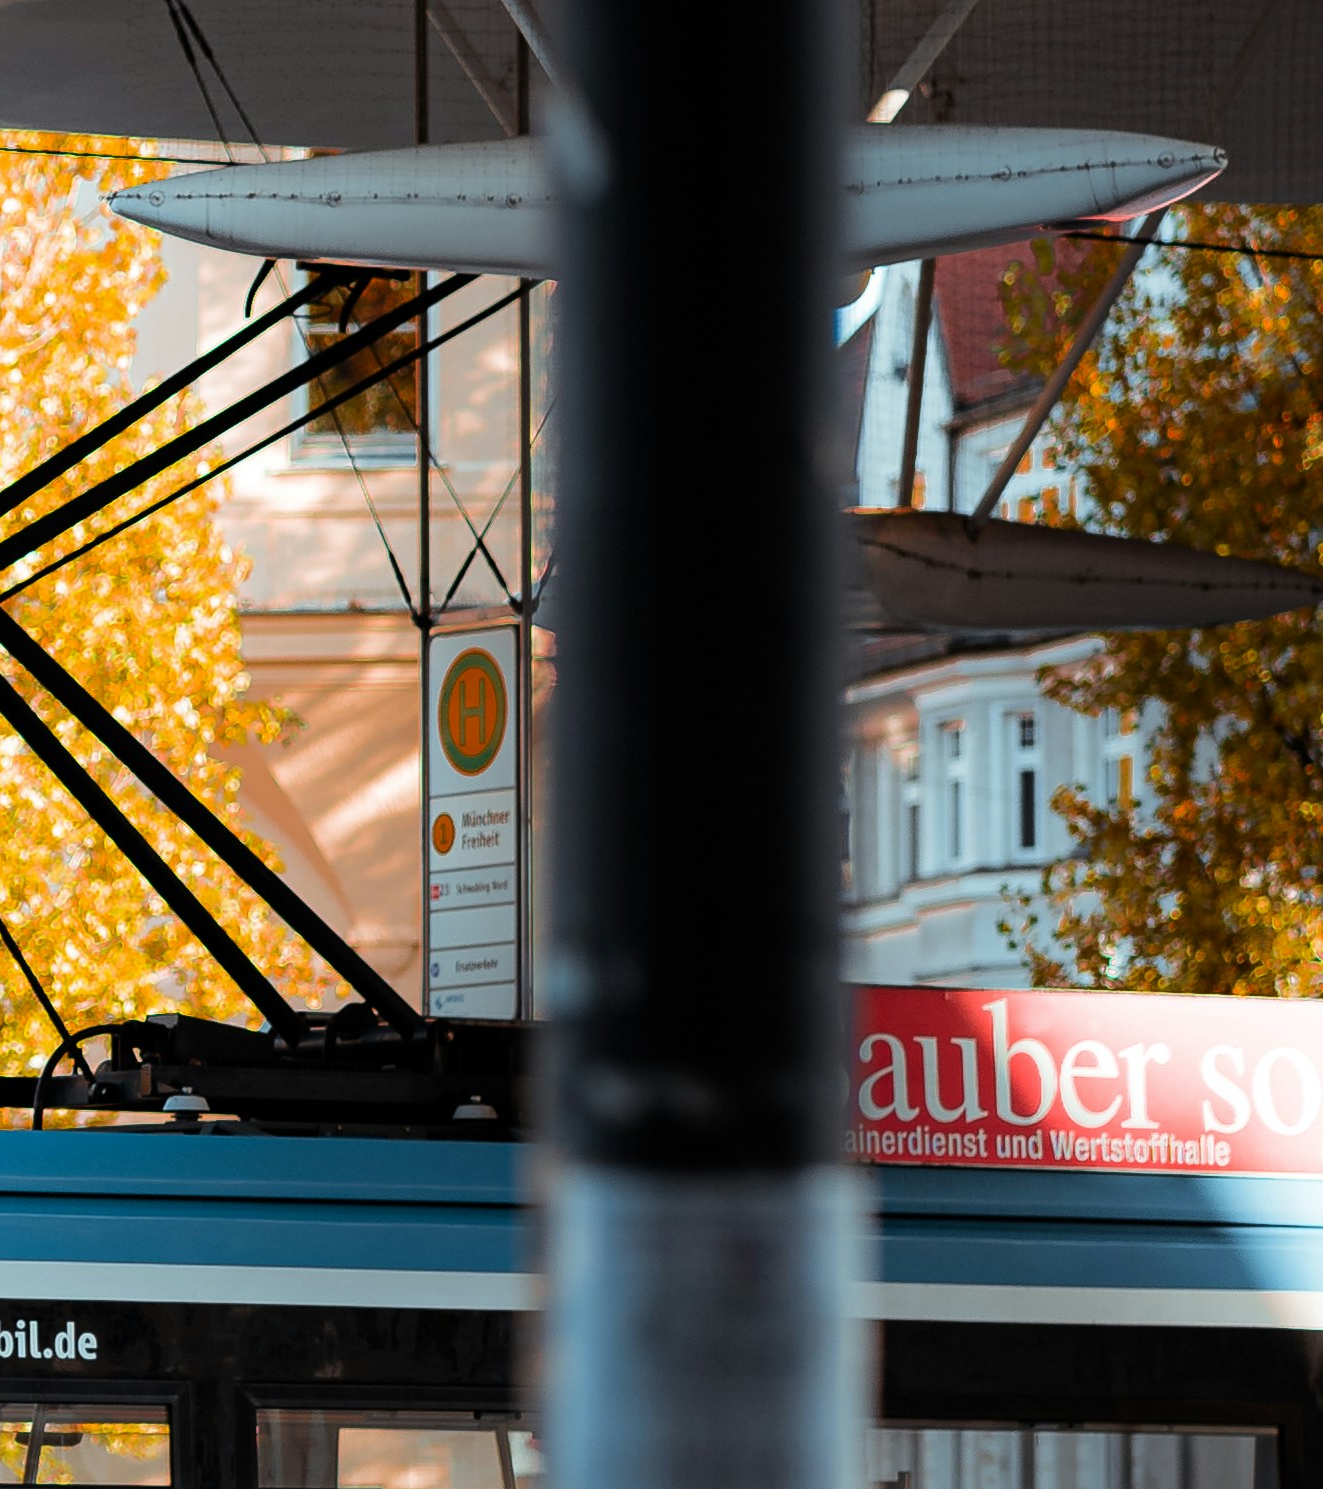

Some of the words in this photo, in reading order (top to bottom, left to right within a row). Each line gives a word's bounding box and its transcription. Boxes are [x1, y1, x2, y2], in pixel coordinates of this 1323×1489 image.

[459, 678, 486, 747] H
[439, 822, 448, 845] 1
[461, 809, 510, 828] Münchner
[461, 831, 499, 850] Freiheit
[844, 998, 1172, 1129] auber
[1200, 1044, 1323, 1136] so
[996, 1129, 1044, 1161] und
[1050, 1129, 1232, 1168] Wertstoffhalle
